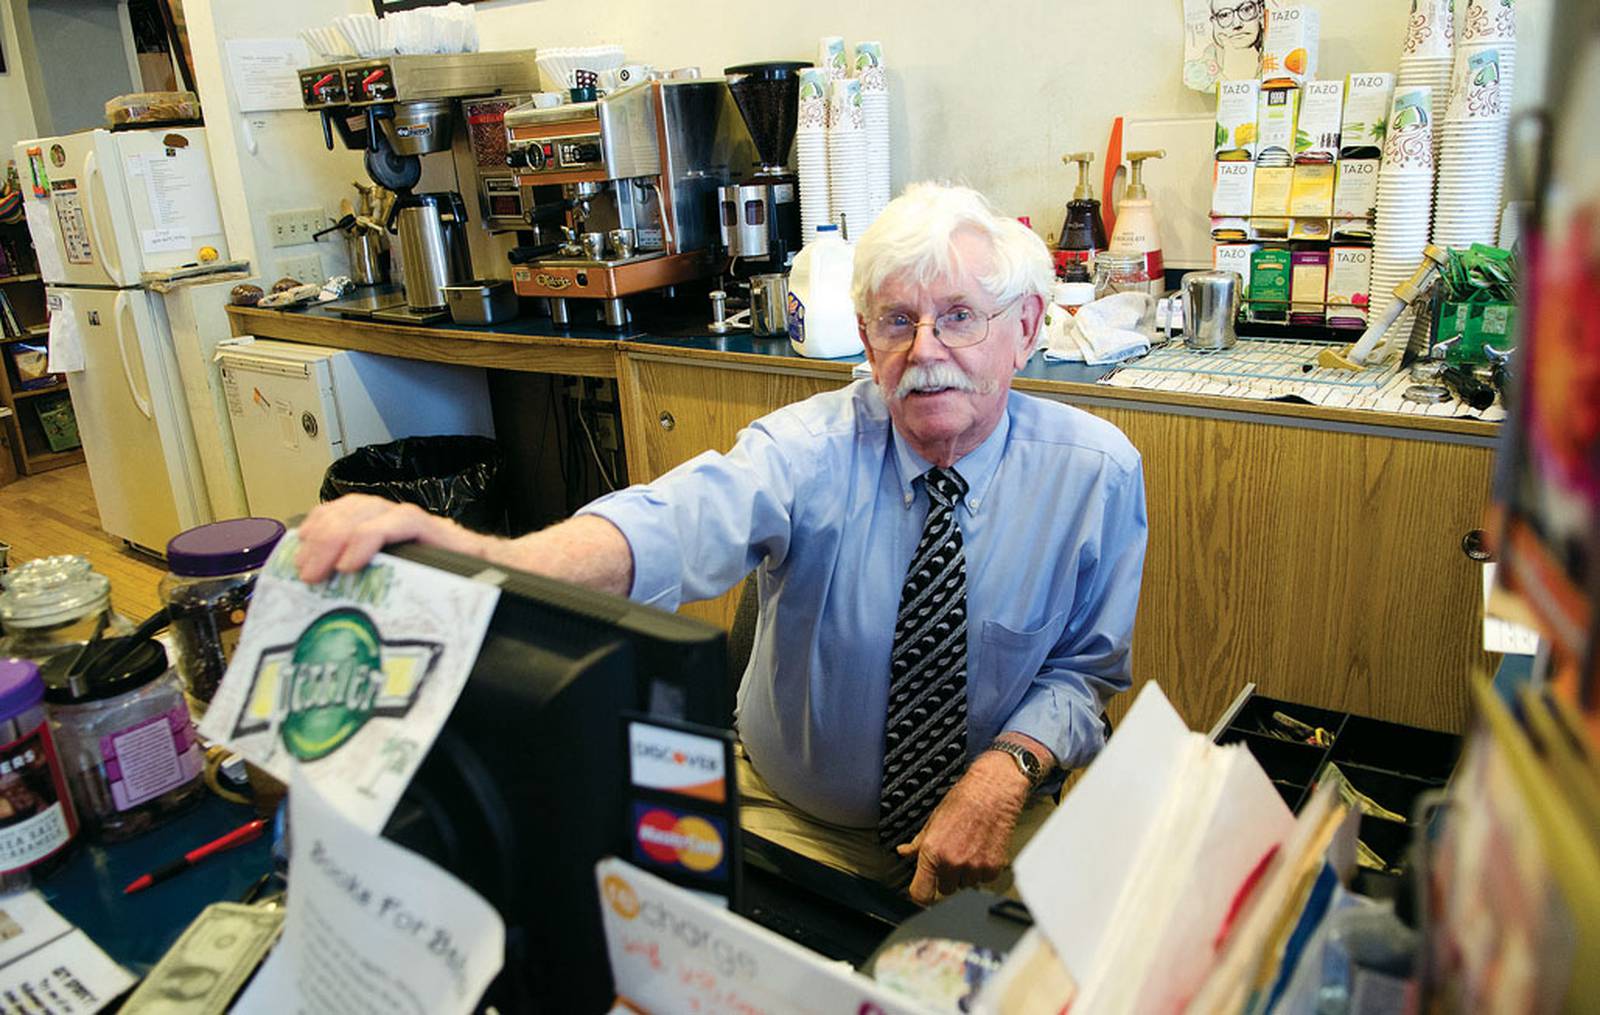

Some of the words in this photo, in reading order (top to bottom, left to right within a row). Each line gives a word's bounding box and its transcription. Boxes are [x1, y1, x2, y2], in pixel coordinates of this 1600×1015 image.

[1271, 9, 1300, 22] TAZO
[1353, 76, 1384, 89] TAZO
[1222, 83, 1251, 96] TAZO
[1308, 84, 1339, 96] TAZO
[1219, 164, 1248, 176] TAZO
[1343, 162, 1374, 175] TAZO
[1218, 248, 1247, 260] TAZO
[1336, 252, 1366, 264] TAZO
[636, 741, 719, 771] DISCOVER
